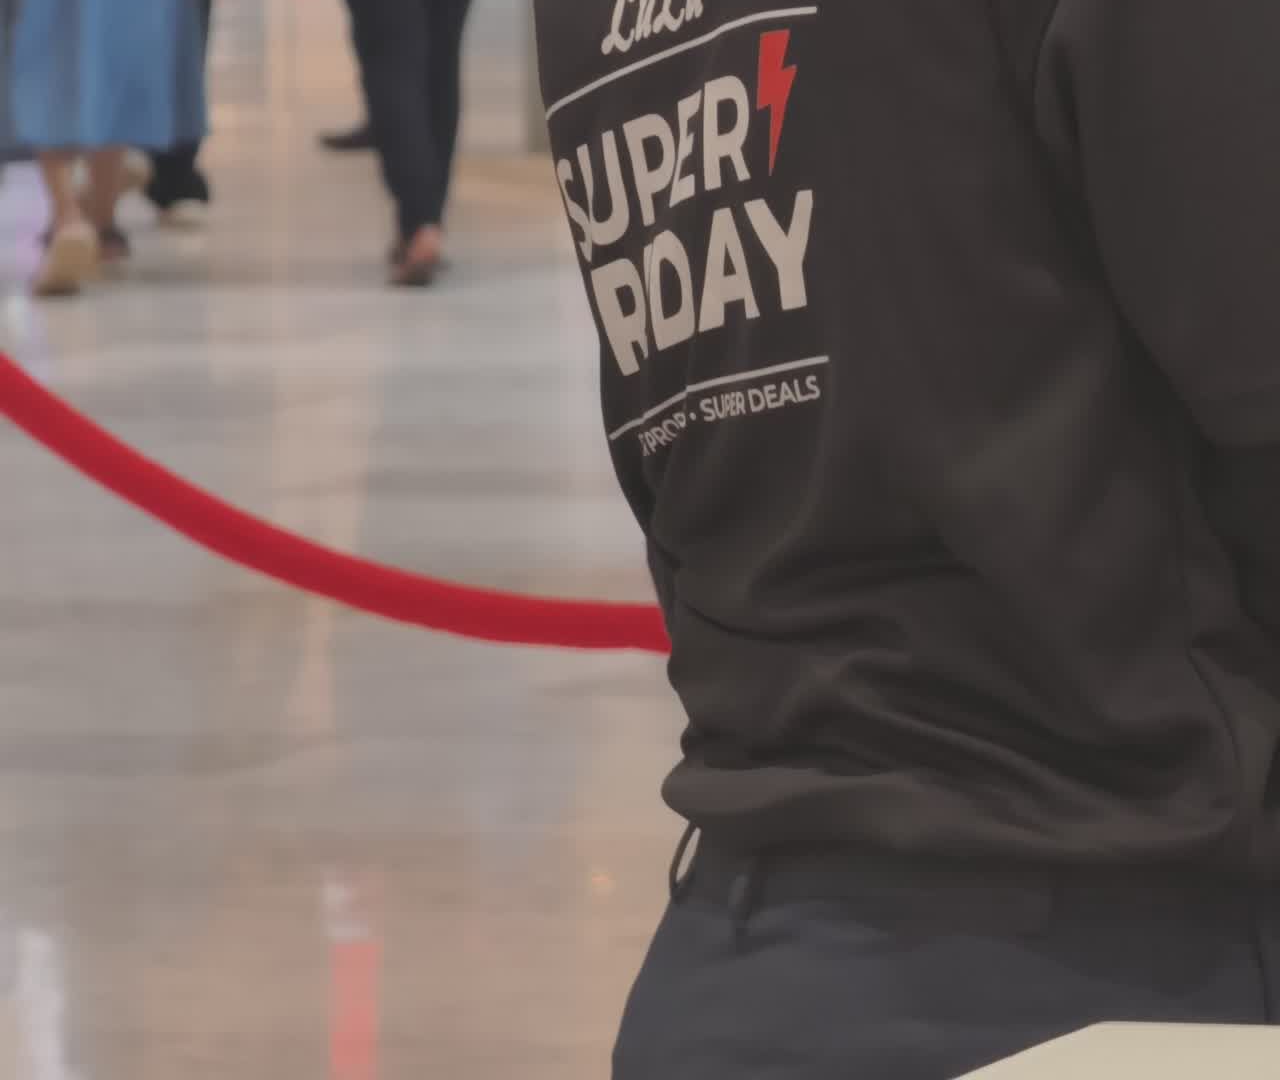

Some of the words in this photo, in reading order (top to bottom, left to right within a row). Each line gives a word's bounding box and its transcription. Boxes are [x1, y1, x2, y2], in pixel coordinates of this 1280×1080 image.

[556, 75, 751, 263] SUPER
[700, 391, 746, 422] SUPER
[748, 375, 821, 413] DEALS
